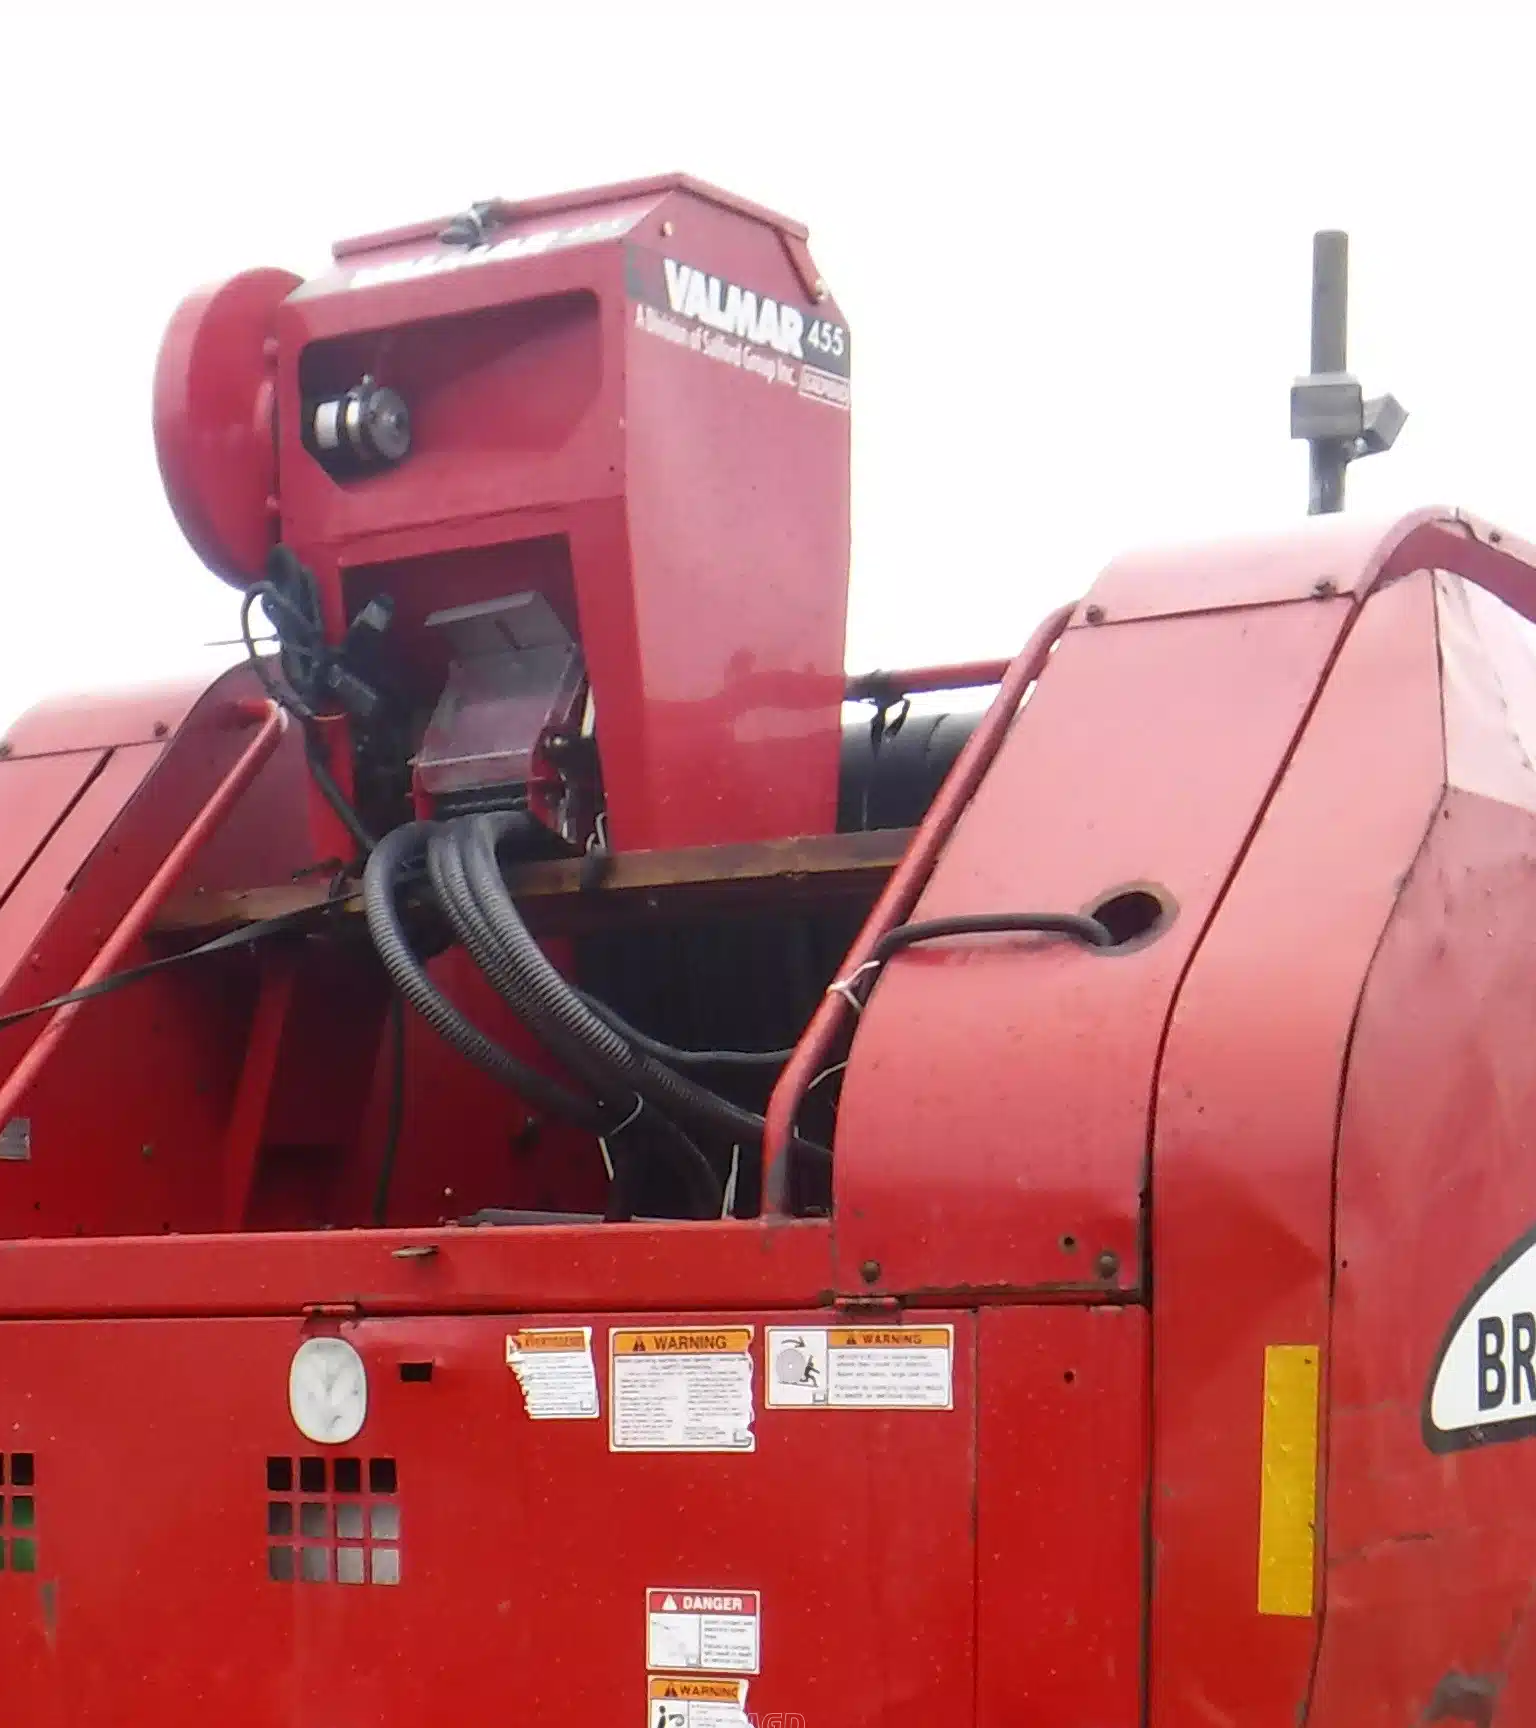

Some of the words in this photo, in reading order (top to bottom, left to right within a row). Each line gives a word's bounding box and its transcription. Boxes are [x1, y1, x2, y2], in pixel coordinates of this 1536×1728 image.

[664, 257, 804, 360] VALMAR
[807, 319, 844, 357] 455
[654, 1336, 727, 1351] WARNING
[862, 1333, 923, 1345] WARNING
[682, 1596, 743, 1611] DANGER
